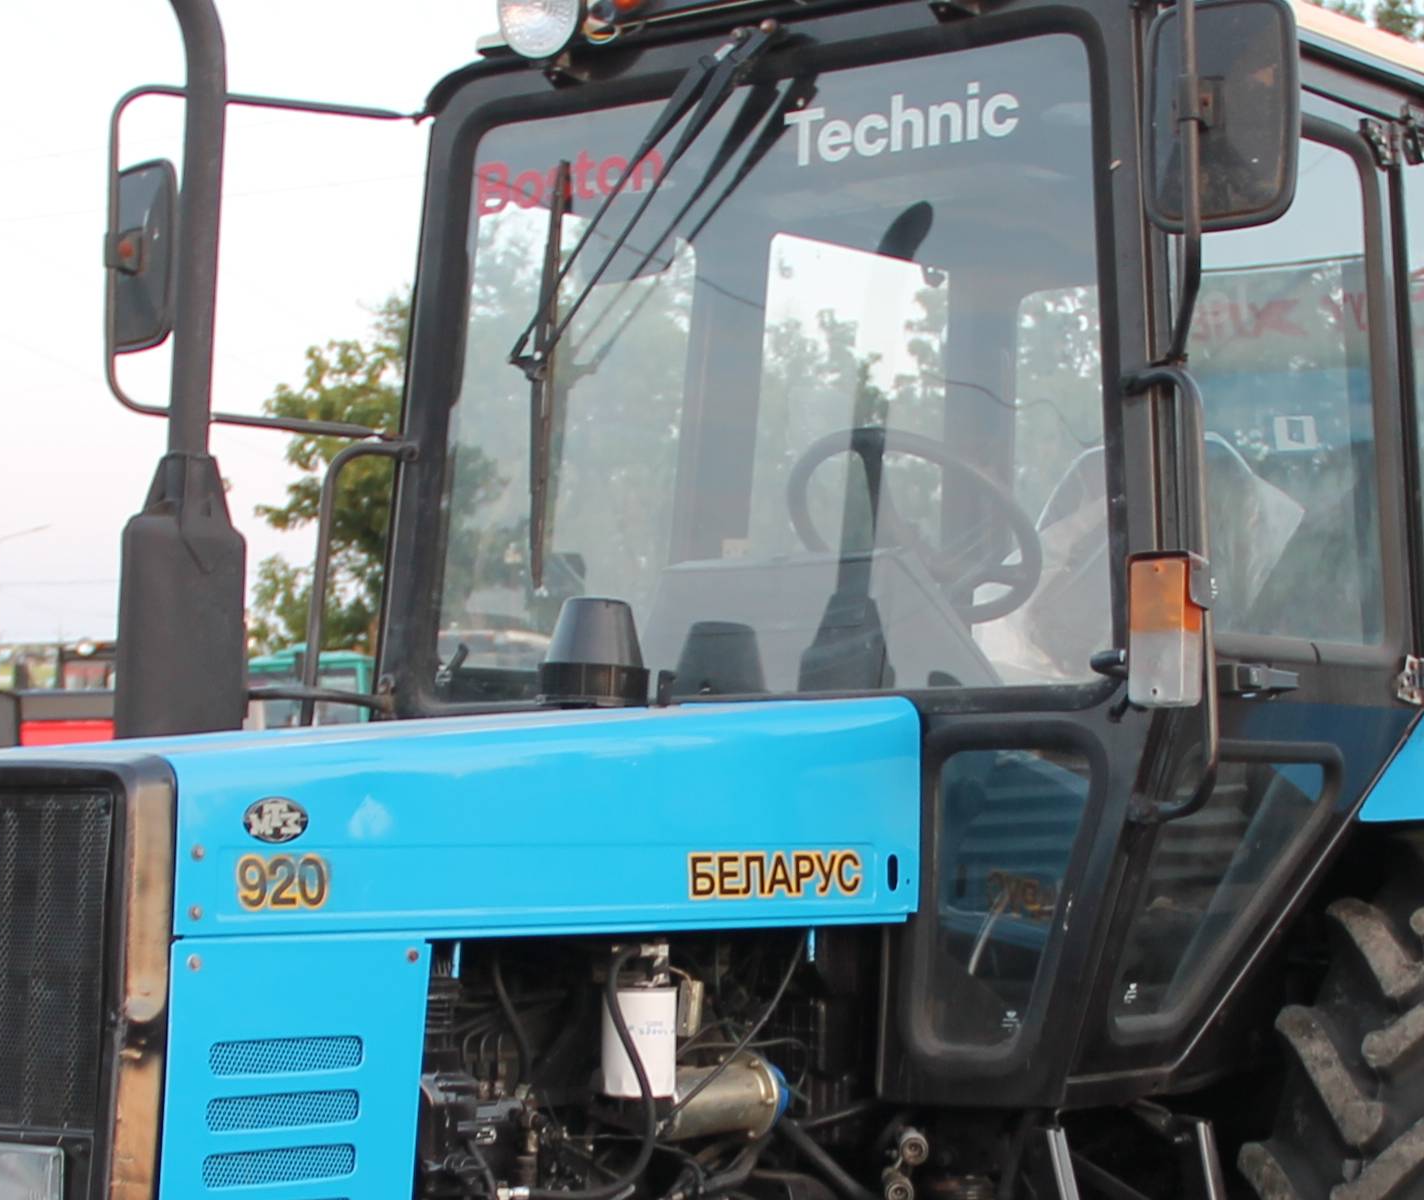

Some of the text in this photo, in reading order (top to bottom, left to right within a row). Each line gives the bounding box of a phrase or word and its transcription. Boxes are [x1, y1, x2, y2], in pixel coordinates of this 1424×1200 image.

[784, 81, 1020, 167] Technic
[237, 853, 328, 912] 920
[688, 851, 862, 900] БЕЛАРУС
